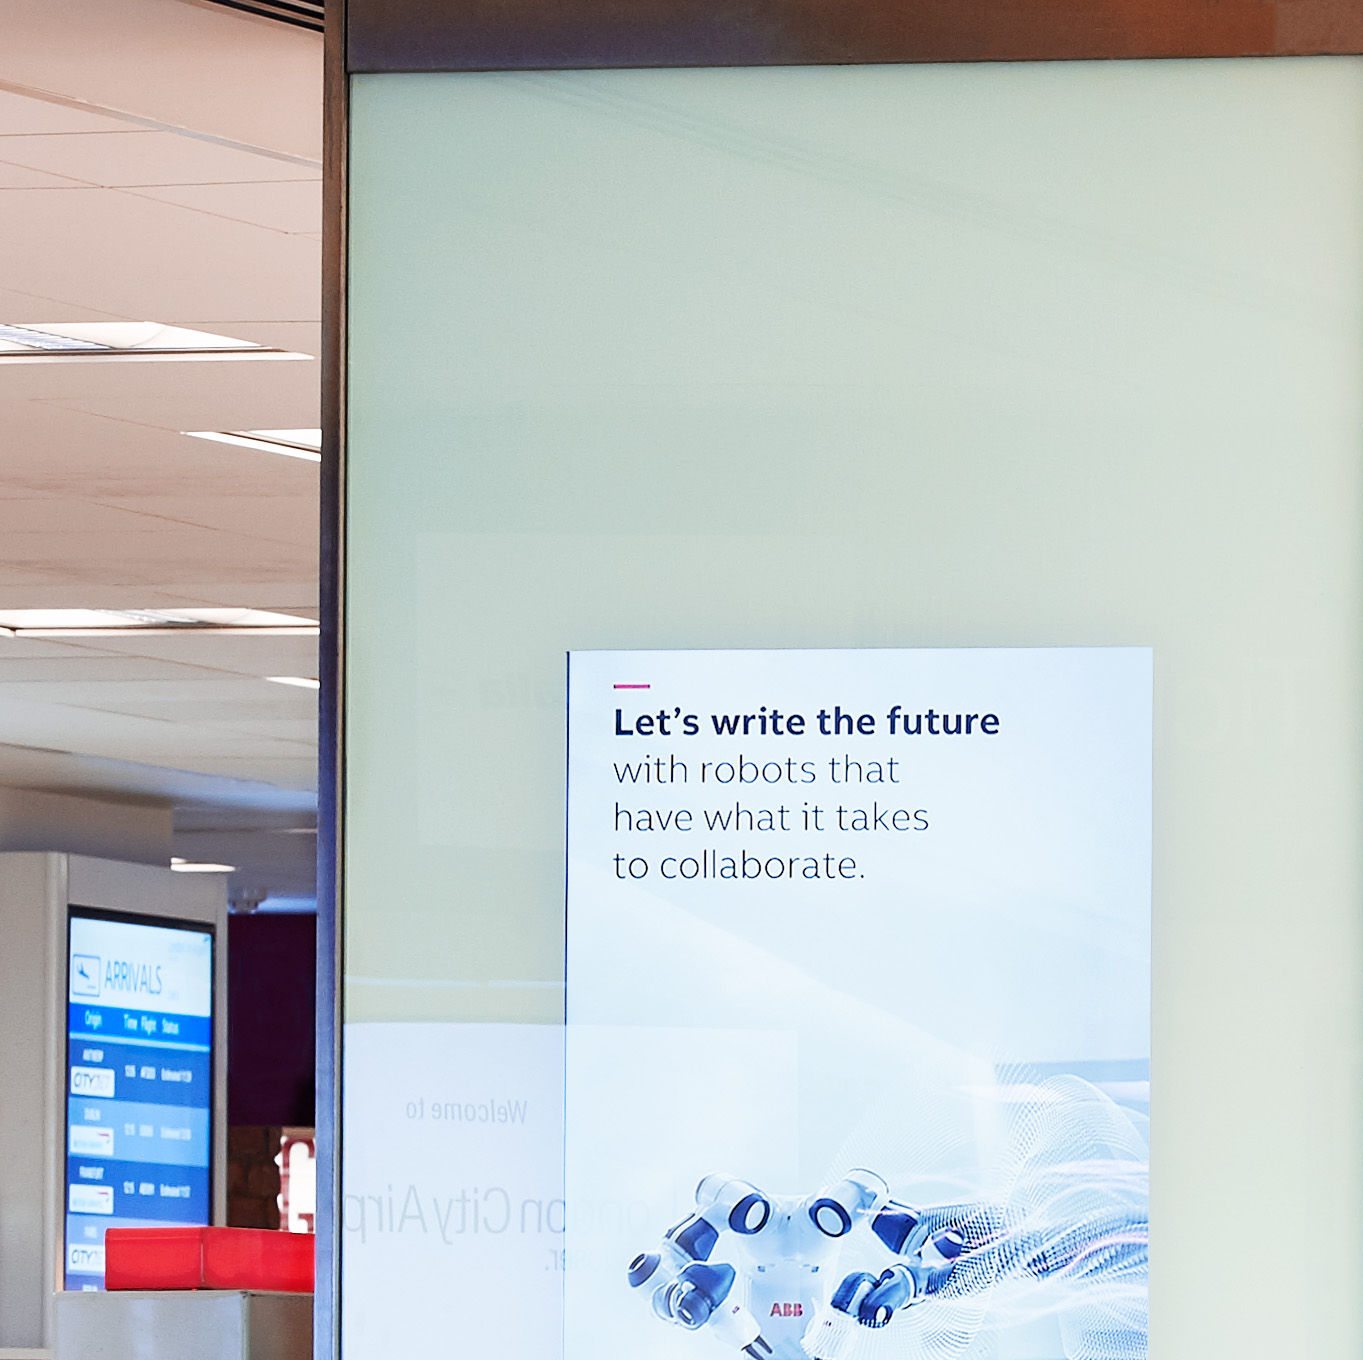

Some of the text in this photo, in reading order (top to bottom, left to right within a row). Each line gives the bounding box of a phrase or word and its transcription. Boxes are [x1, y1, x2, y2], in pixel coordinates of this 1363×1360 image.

[614, 706, 1000, 736] Let’s write the future
[613, 755, 900, 784] with robots that
[614, 802, 929, 832] have what it takes
[613, 850, 866, 880] to collaborate.
[104, 959, 162, 995] ARRIVALS
[770, 1302, 802, 1317] ABB
